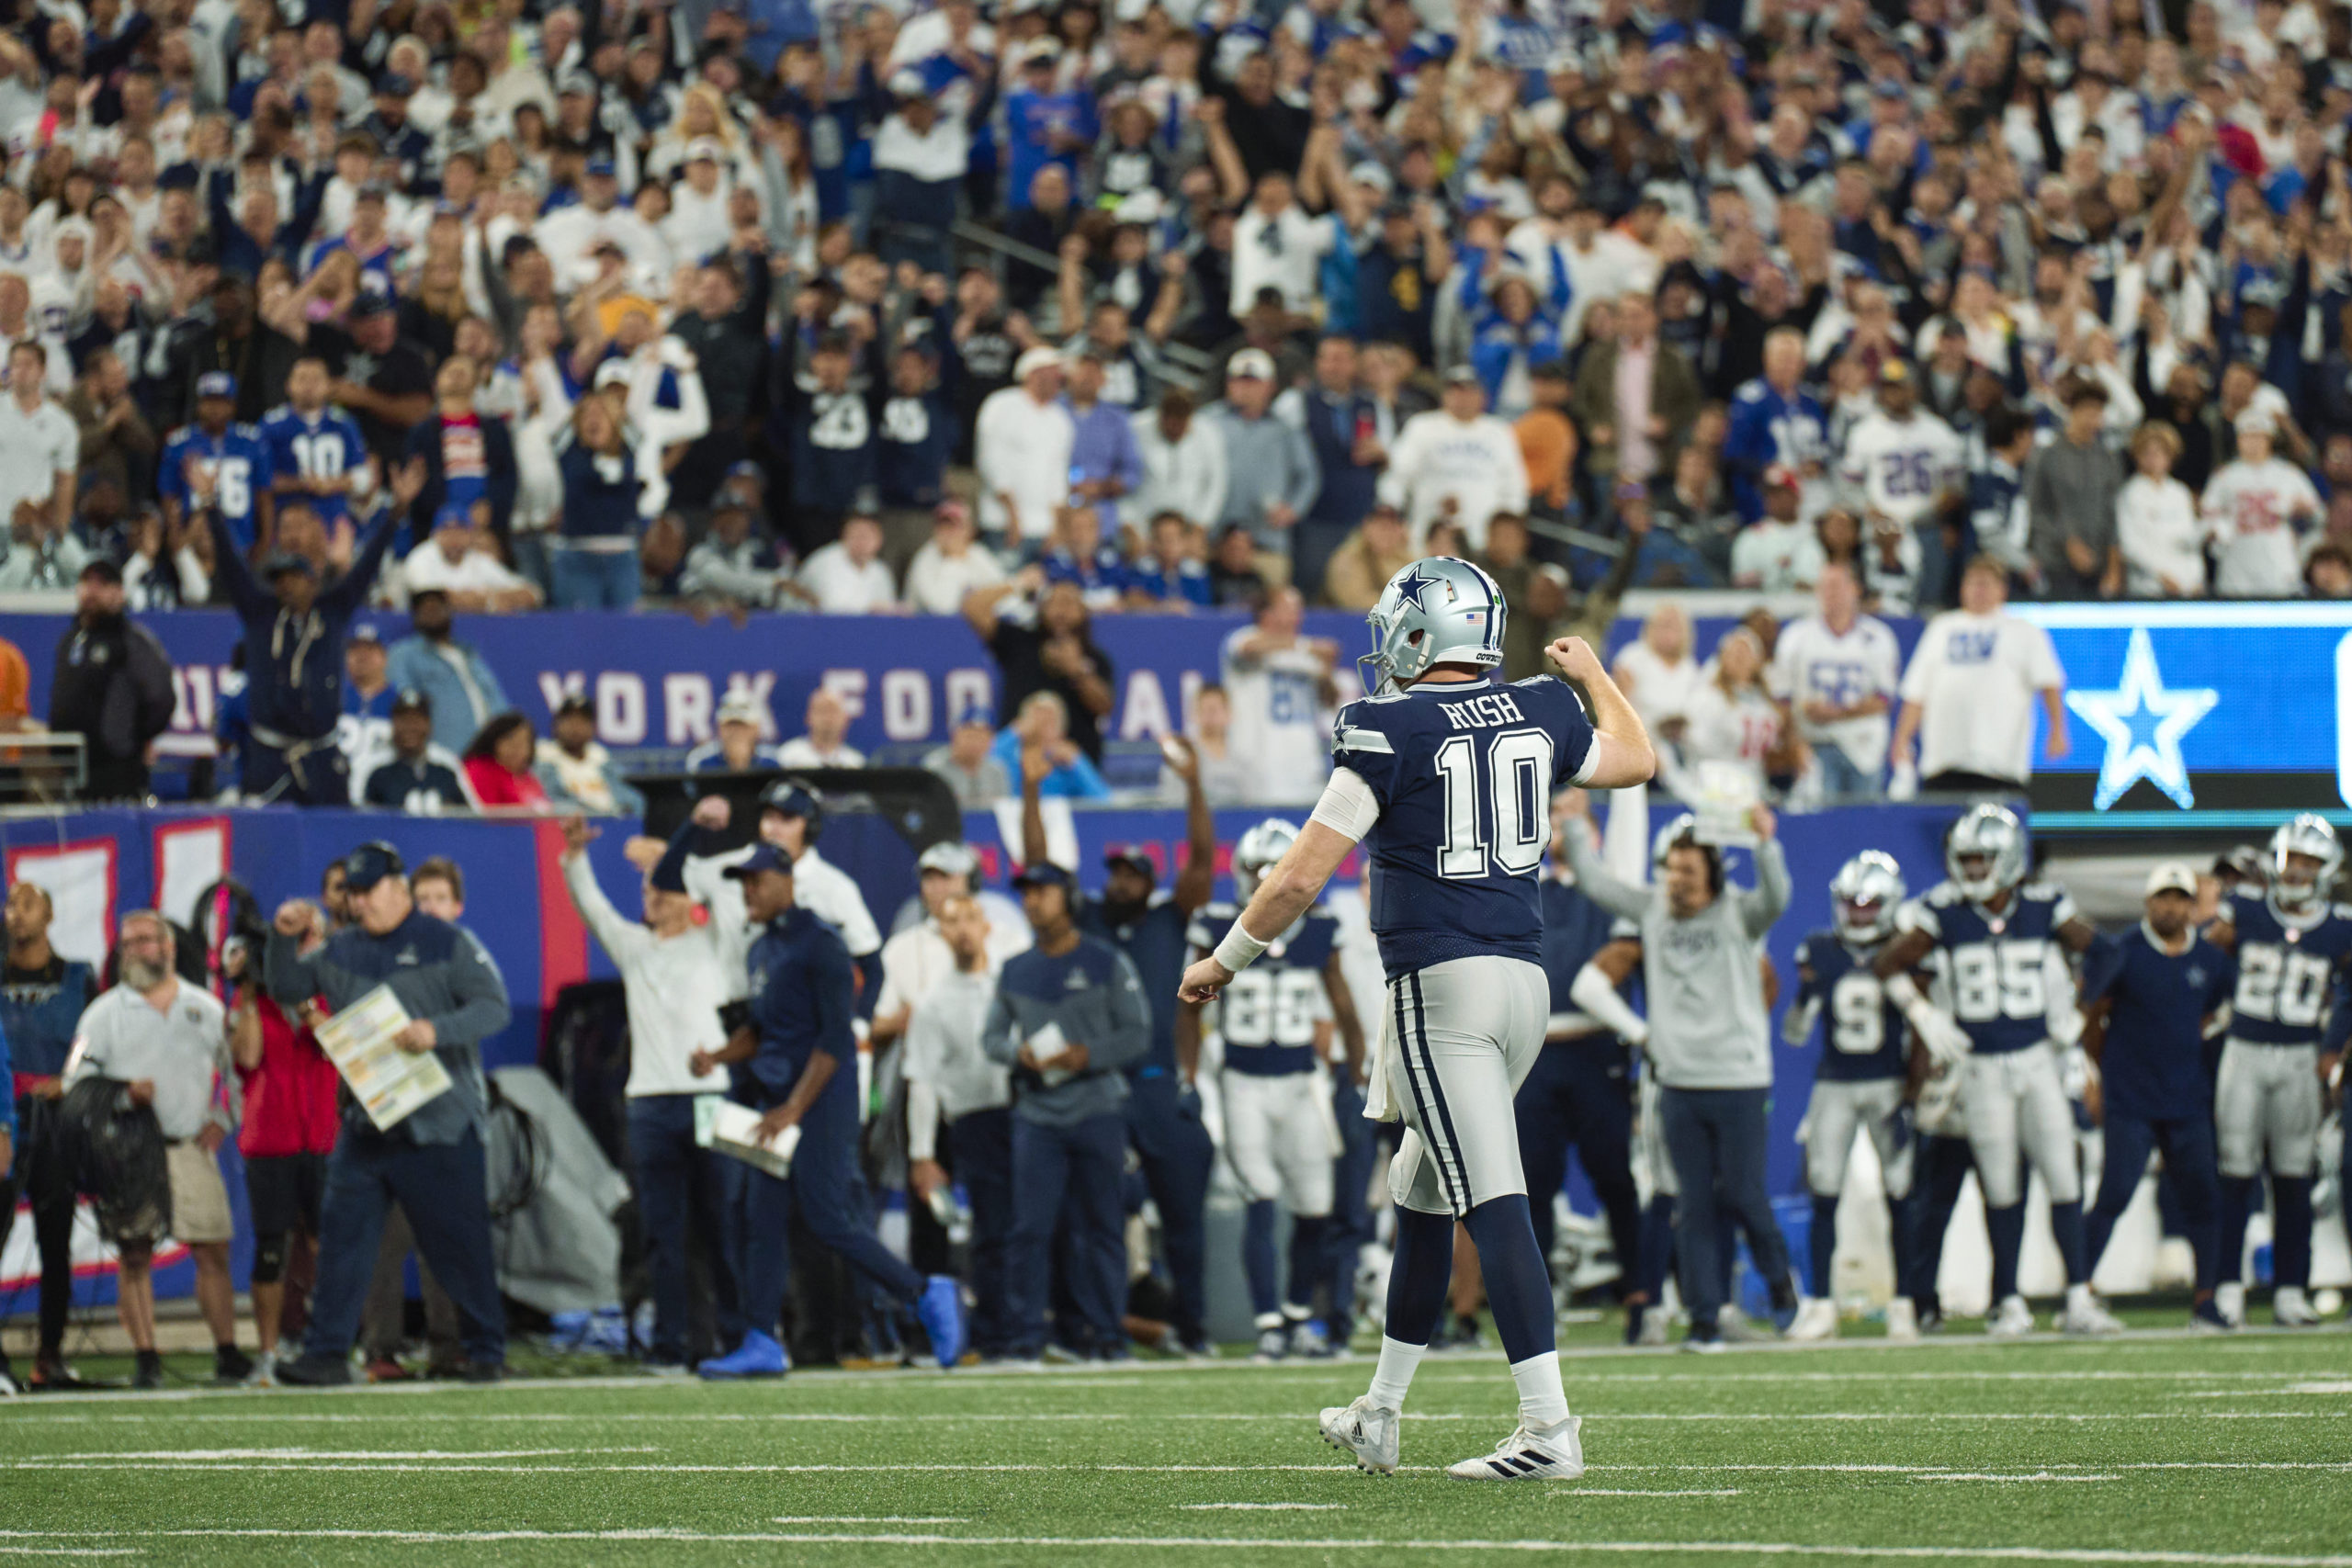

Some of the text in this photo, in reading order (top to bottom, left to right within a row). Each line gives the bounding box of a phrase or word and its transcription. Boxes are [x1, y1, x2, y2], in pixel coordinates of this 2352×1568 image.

[1476, 652, 1502, 663] COWBO
[1437, 693, 1525, 730] RUSH
[1434, 727, 1554, 879] 10
[1832, 970, 1884, 1055] 9
[1952, 939, 2044, 1023] 85
[2233, 940, 2332, 1027] 20
